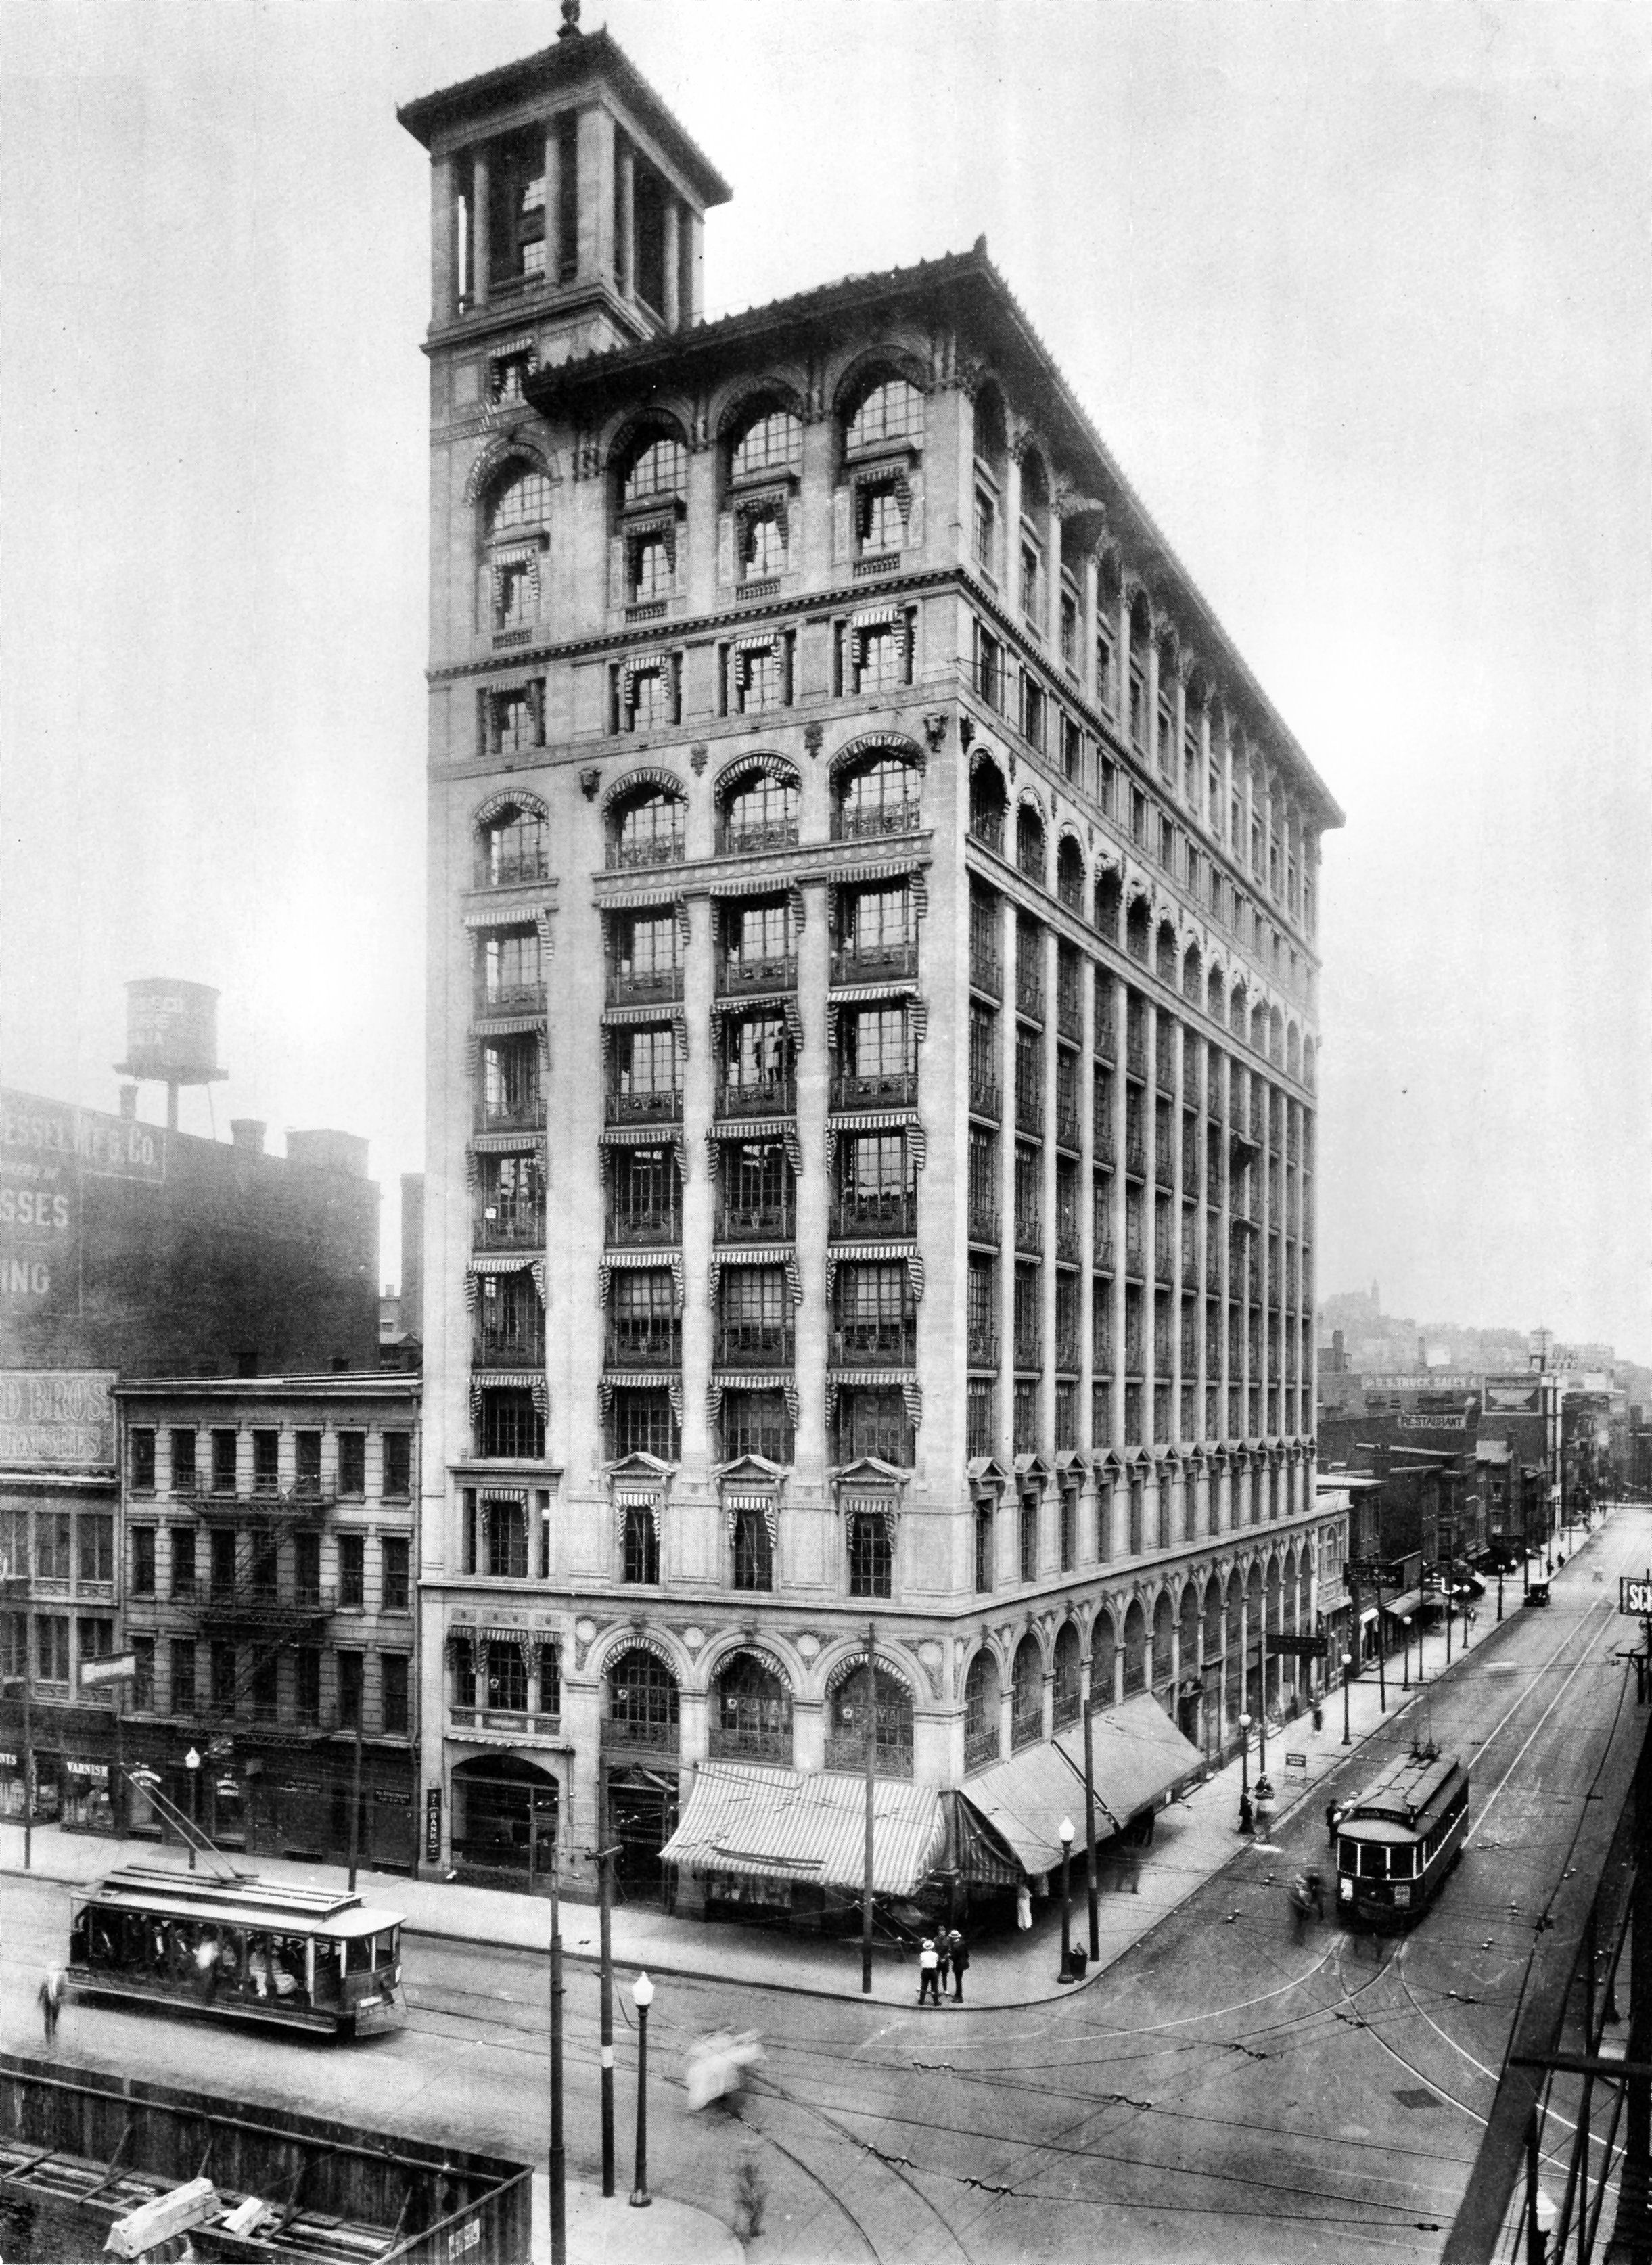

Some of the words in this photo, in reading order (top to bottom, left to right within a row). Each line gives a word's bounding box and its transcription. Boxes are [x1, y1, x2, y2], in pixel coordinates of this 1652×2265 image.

[1401, 1417, 1462, 1427] RESTAURANT
[739, 1697, 789, 1715] ROYAL
[66, 1761, 108, 1777] VARNISH
